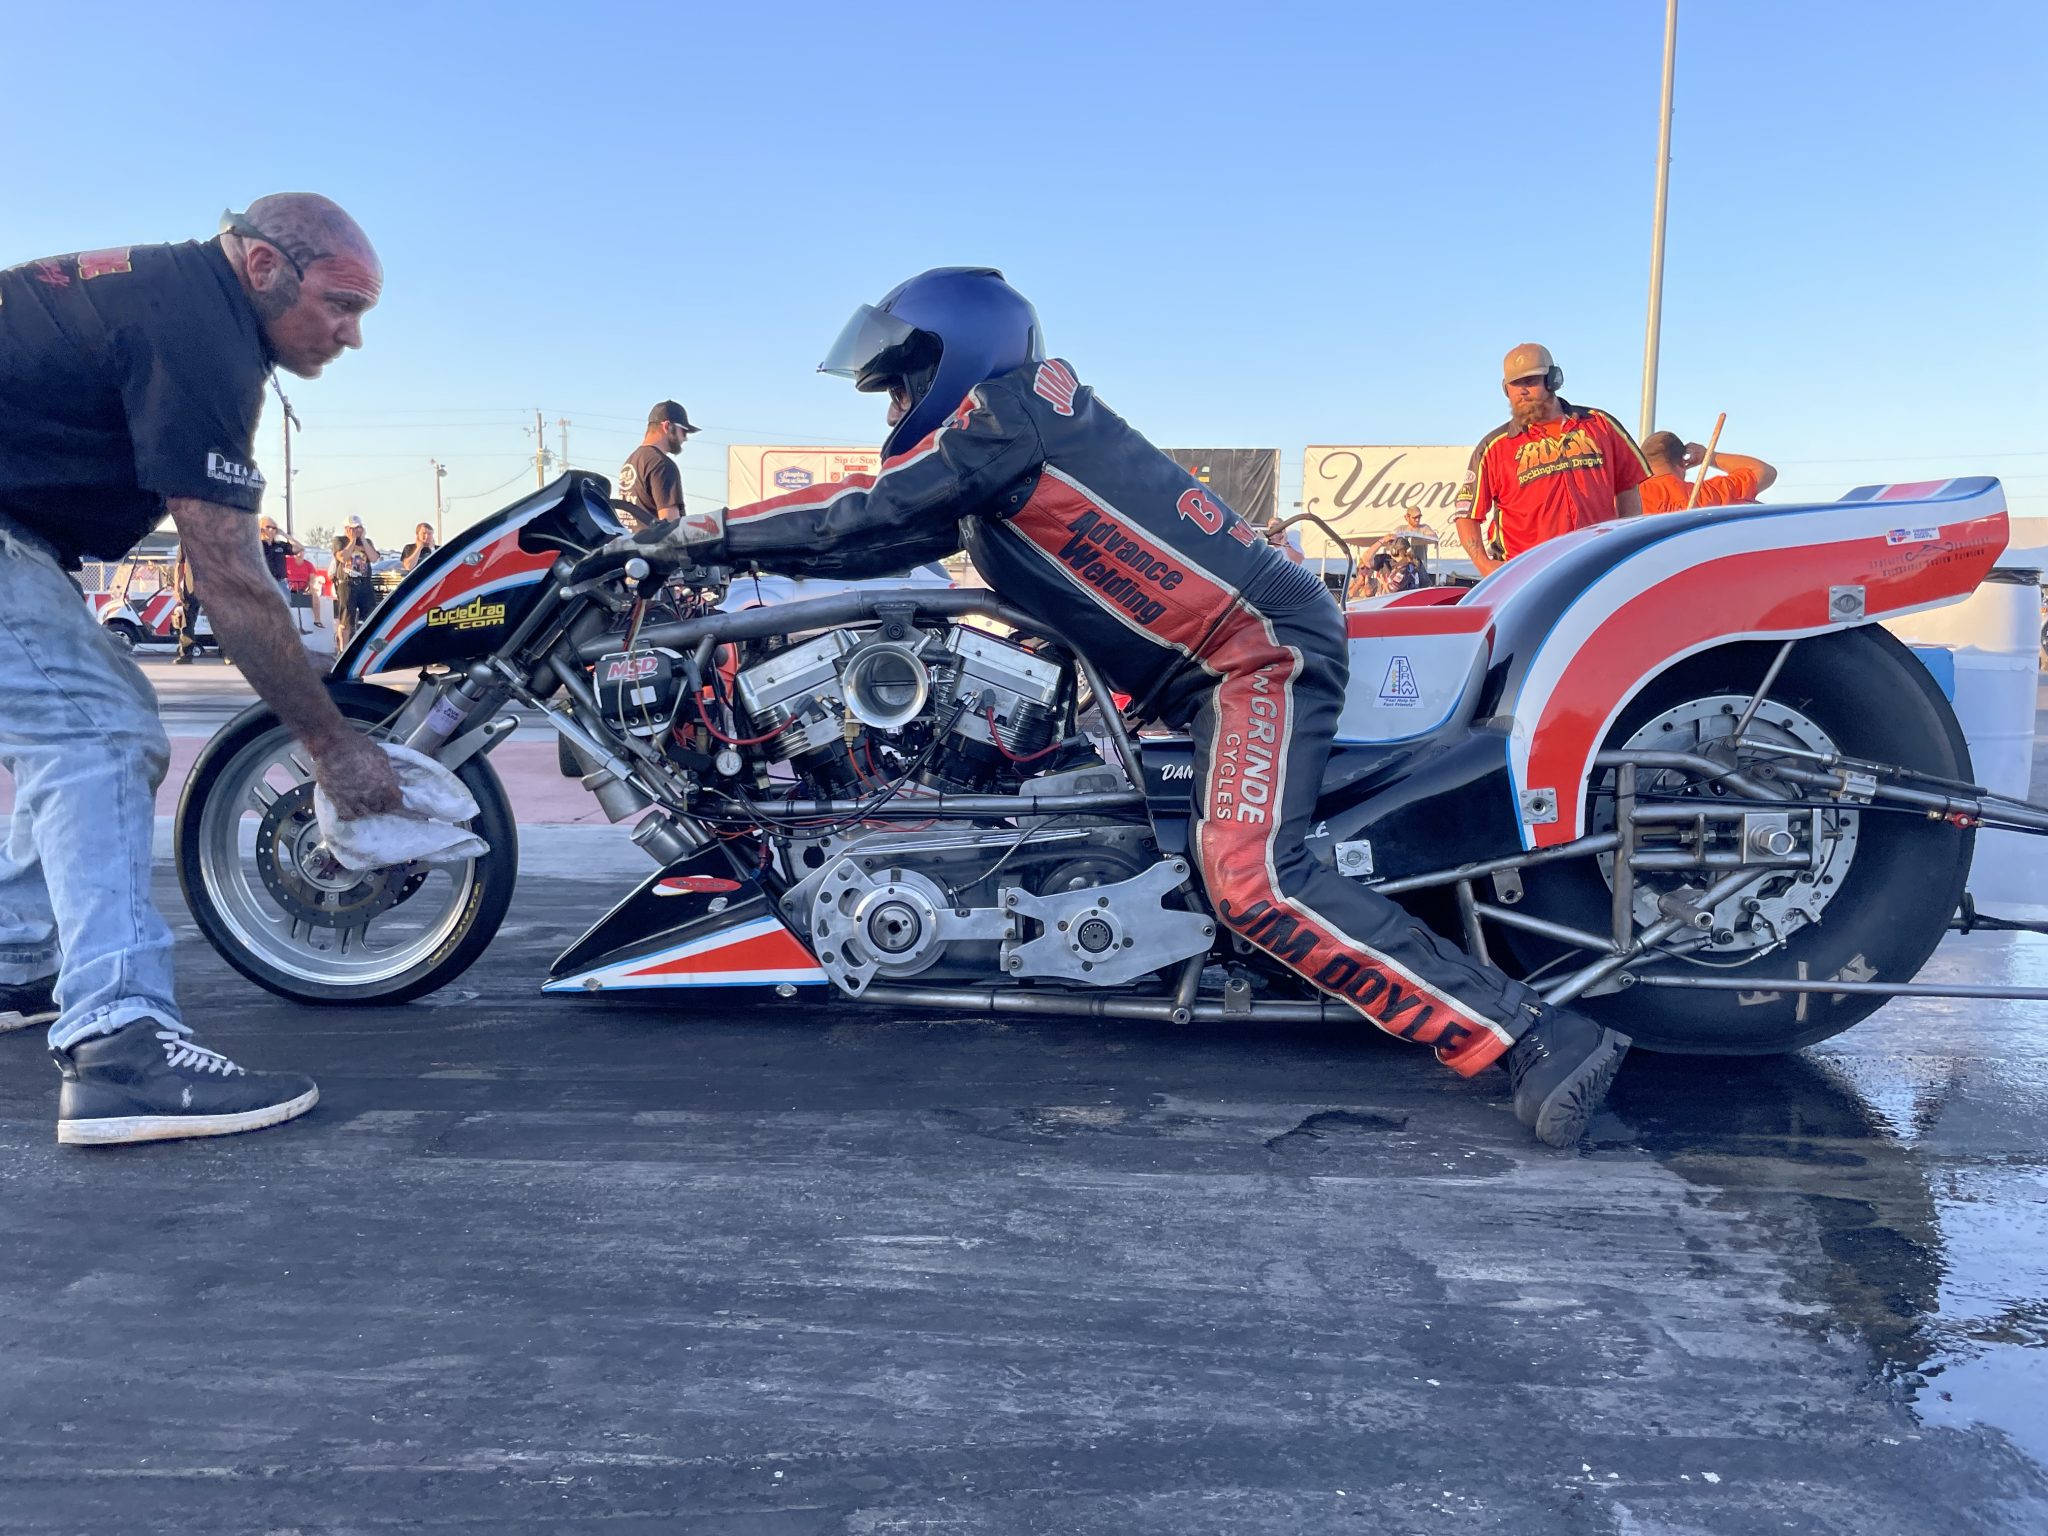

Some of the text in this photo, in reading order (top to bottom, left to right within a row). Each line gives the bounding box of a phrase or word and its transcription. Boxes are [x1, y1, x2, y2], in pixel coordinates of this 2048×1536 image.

[1308, 451, 1459, 522] Yuen
[1058, 532, 1167, 625] Welding
[1067, 510, 1184, 591] Advance
[606, 656, 659, 681] MSD
[1216, 733, 1242, 821] CYCLES
[1220, 898, 1472, 1060] JIM DOYLE
